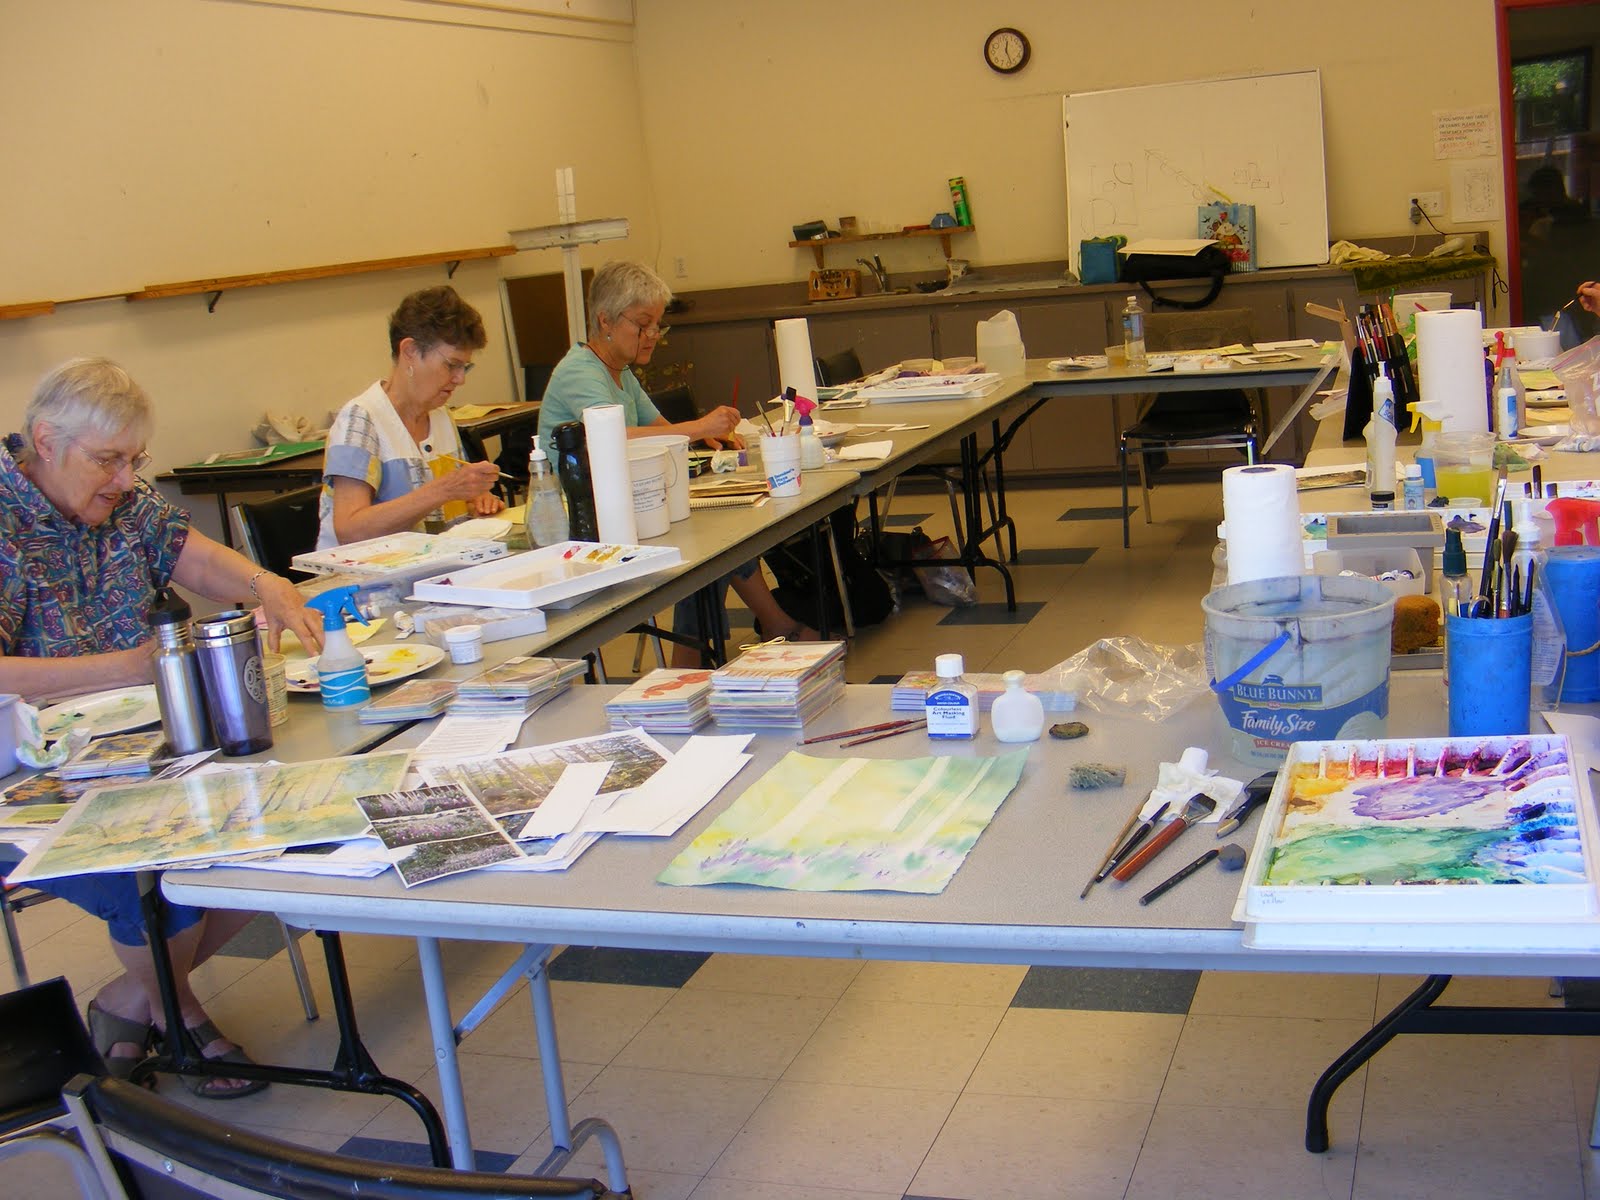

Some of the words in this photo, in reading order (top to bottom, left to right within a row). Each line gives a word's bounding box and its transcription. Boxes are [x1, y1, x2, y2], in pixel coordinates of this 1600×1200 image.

[1236, 684, 1265, 699] BLUE
[1268, 687, 1316, 701] BUNNY
[1241, 709, 1284, 736] Family
[1281, 713, 1317, 735] Size
